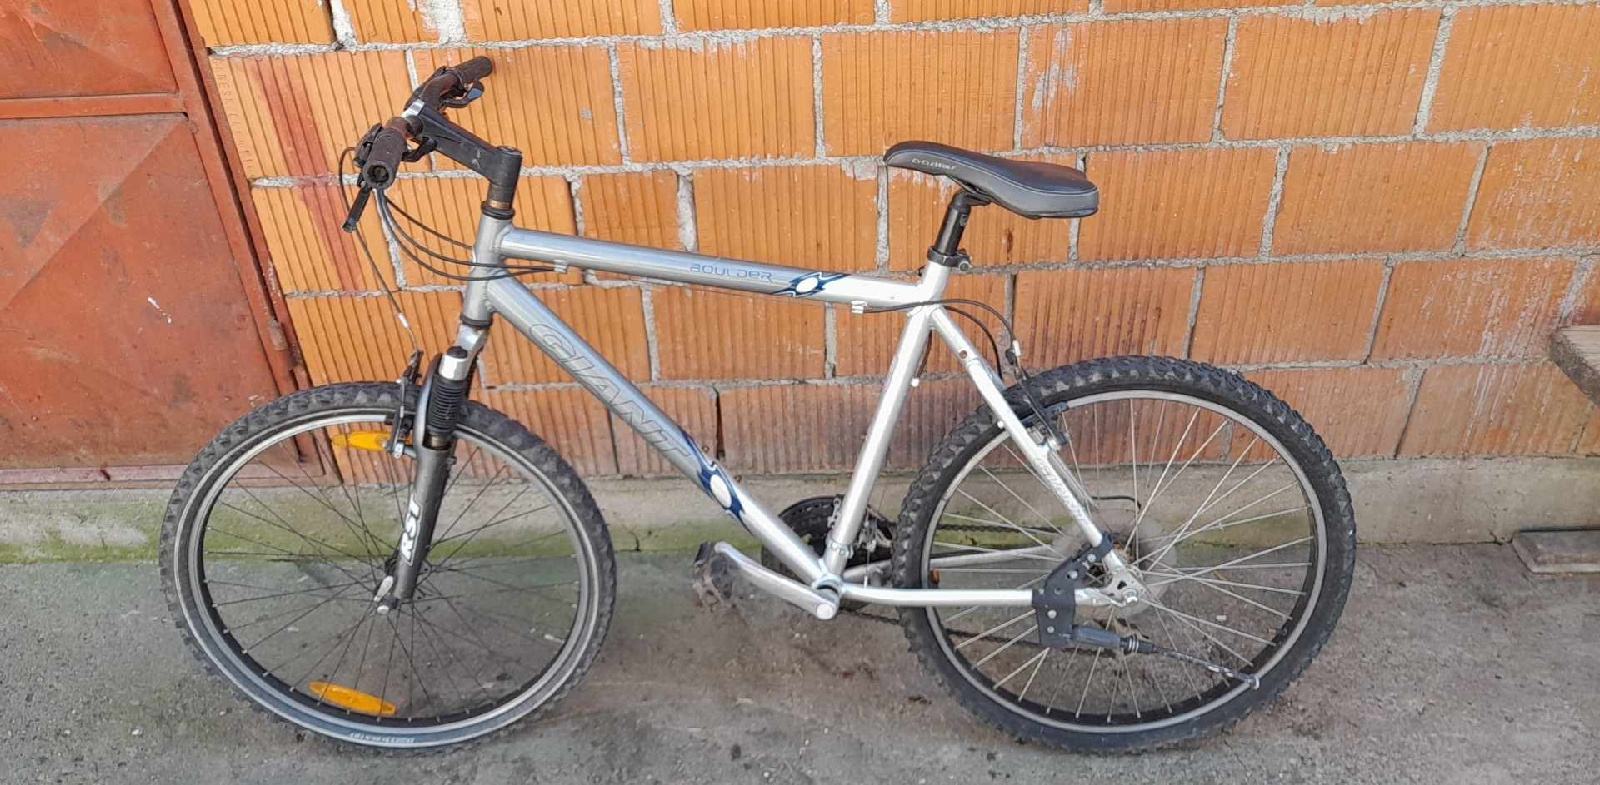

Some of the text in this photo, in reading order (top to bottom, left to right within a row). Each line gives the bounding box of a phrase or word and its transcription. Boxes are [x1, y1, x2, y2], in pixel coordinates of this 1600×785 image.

[690, 263, 774, 283] BOULDER
[529, 323, 690, 458] GIANT
[400, 493, 421, 564] RST
